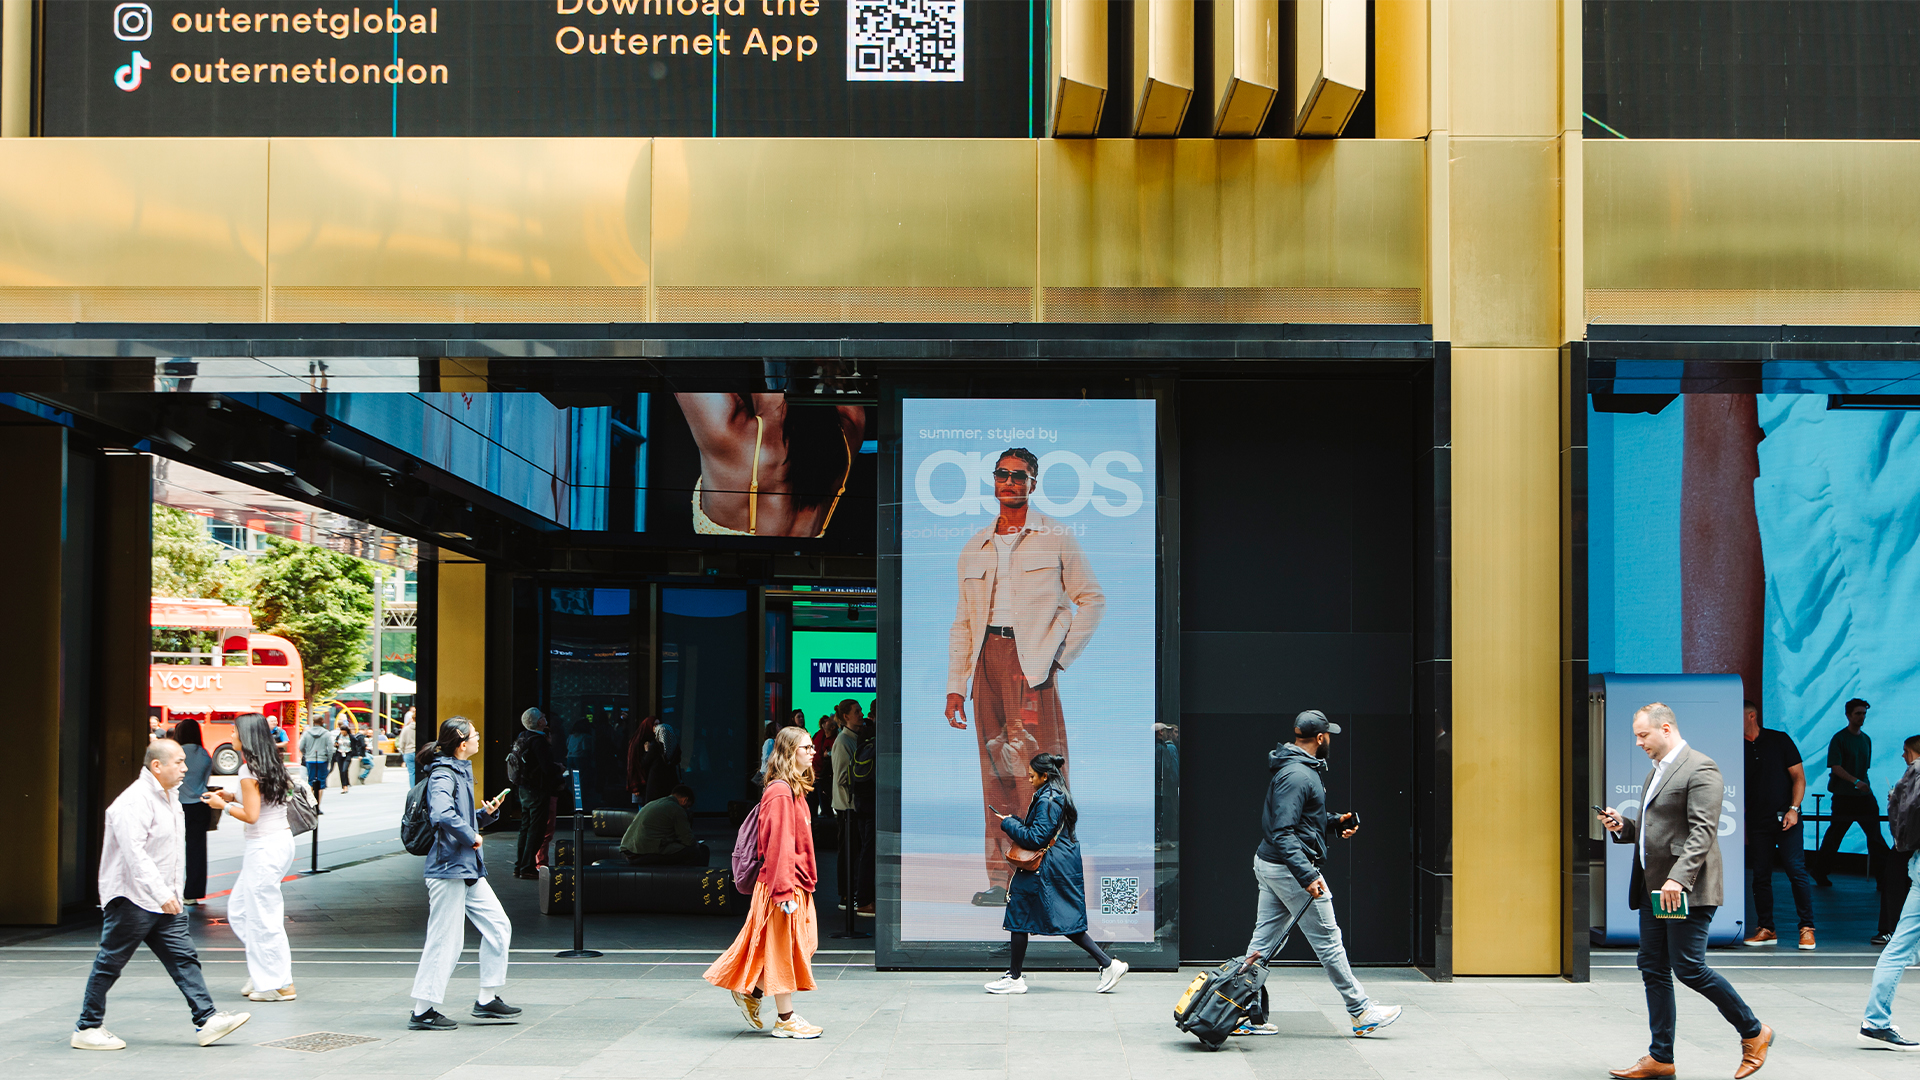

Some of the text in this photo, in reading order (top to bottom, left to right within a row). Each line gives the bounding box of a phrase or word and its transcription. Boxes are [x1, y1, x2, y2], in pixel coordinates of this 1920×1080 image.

[171, 7, 438, 39] outernetglobal
[555, 26, 819, 62] Outernet App
[170, 57, 449, 85] outernetlondon
[919, 427, 1058, 443] summer, styled by
[835, 662, 877, 674] NEIGHBOU
[157, 671, 223, 693] Yogurt
[819, 676, 877, 688] WHEN SHE KN
